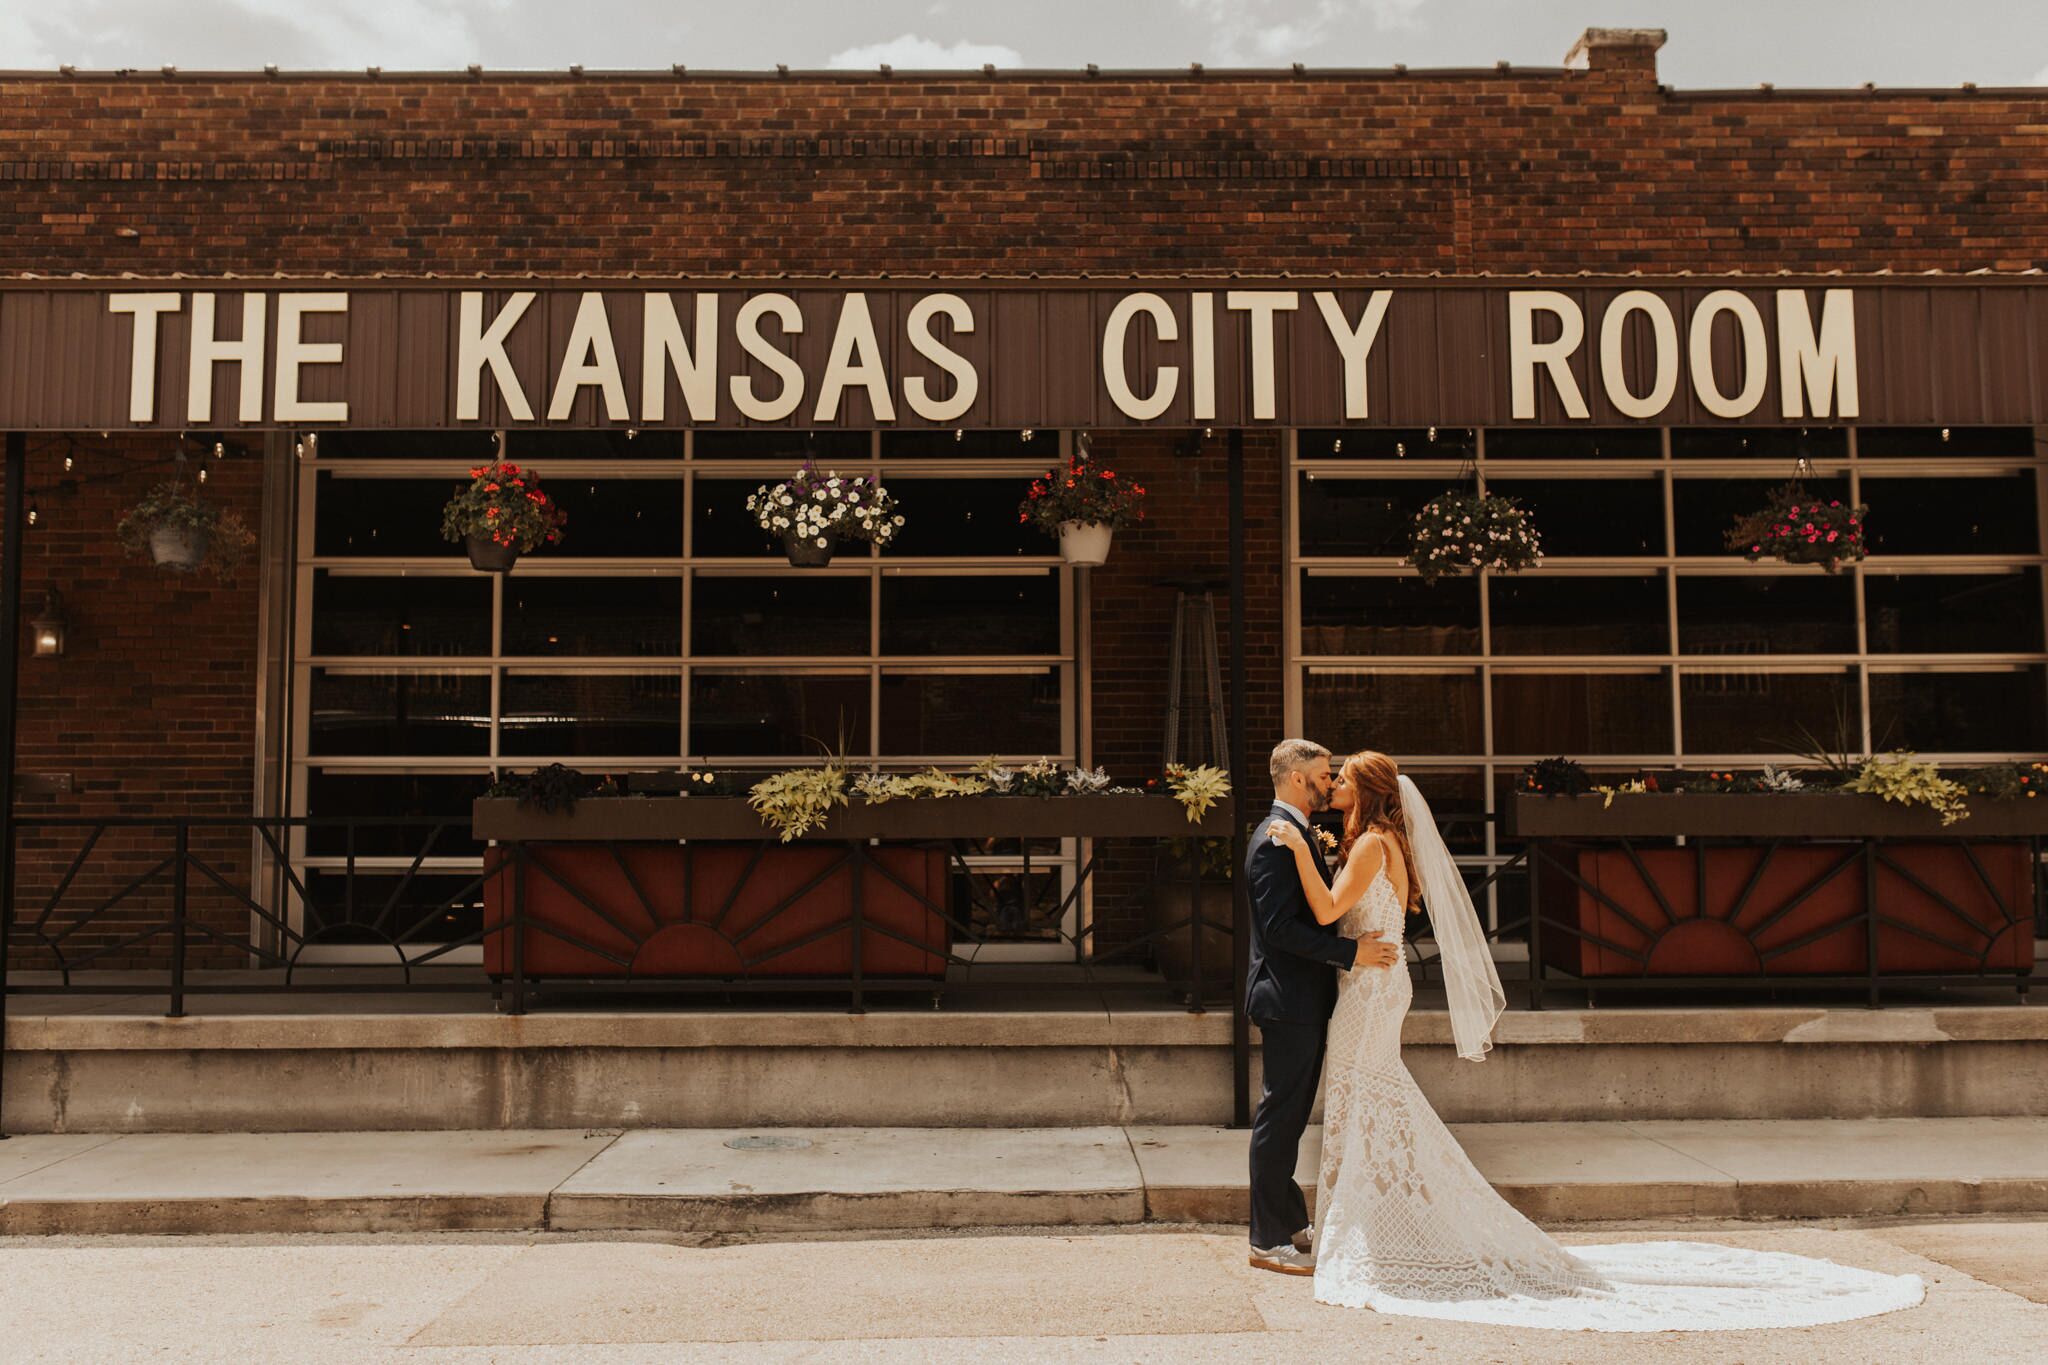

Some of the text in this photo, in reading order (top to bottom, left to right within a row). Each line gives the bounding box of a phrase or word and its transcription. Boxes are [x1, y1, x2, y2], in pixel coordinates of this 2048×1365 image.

[109, 289, 1860, 423] THE KANSAS CITY ROOM
